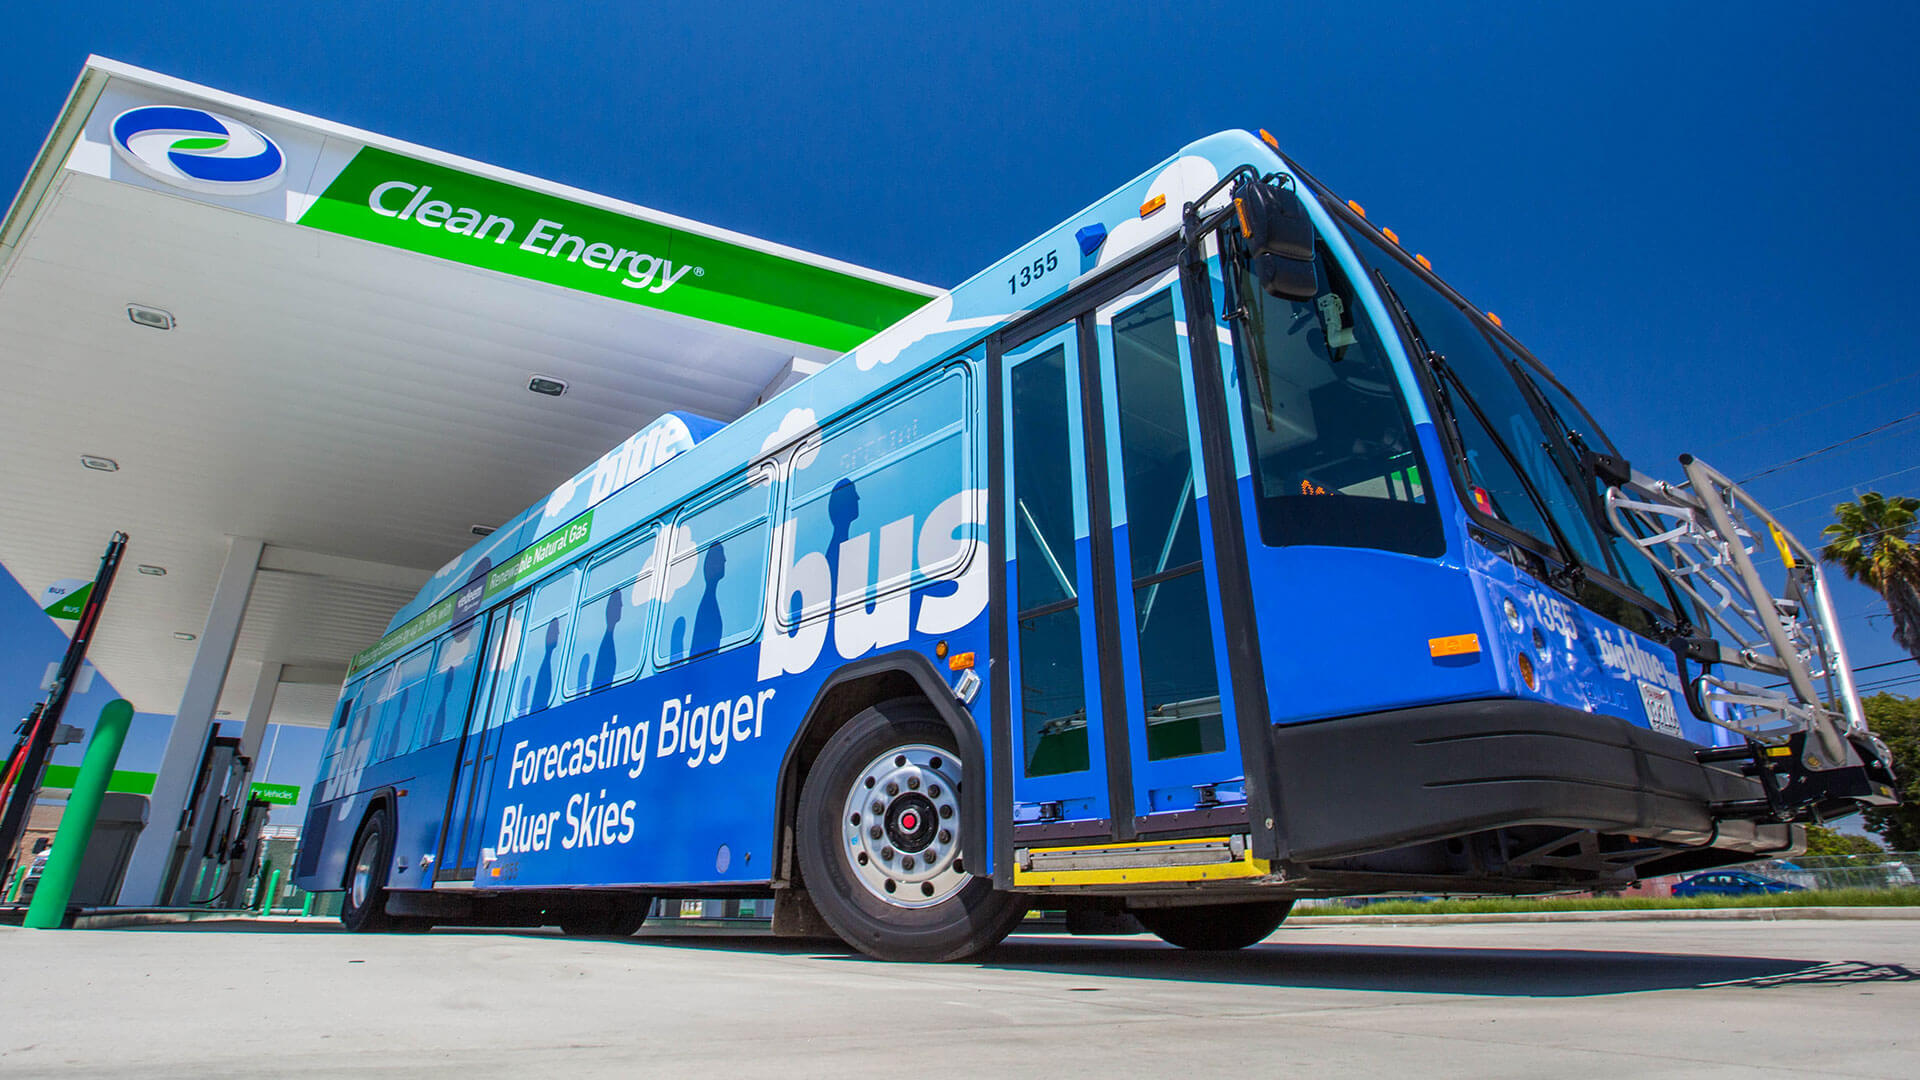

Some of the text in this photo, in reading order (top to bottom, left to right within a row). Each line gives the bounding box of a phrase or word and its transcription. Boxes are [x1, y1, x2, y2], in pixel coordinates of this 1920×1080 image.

[368, 180, 515, 245] Clean
[1008, 249, 1059, 295] 1355
[489, 522, 588, 590] Renewable Natural Gas
[757, 488, 990, 682] bus
[1528, 590, 1578, 640] 1355
[508, 688, 776, 789] Forecasting Bigger
[497, 788, 637, 856] Bluer Skies
